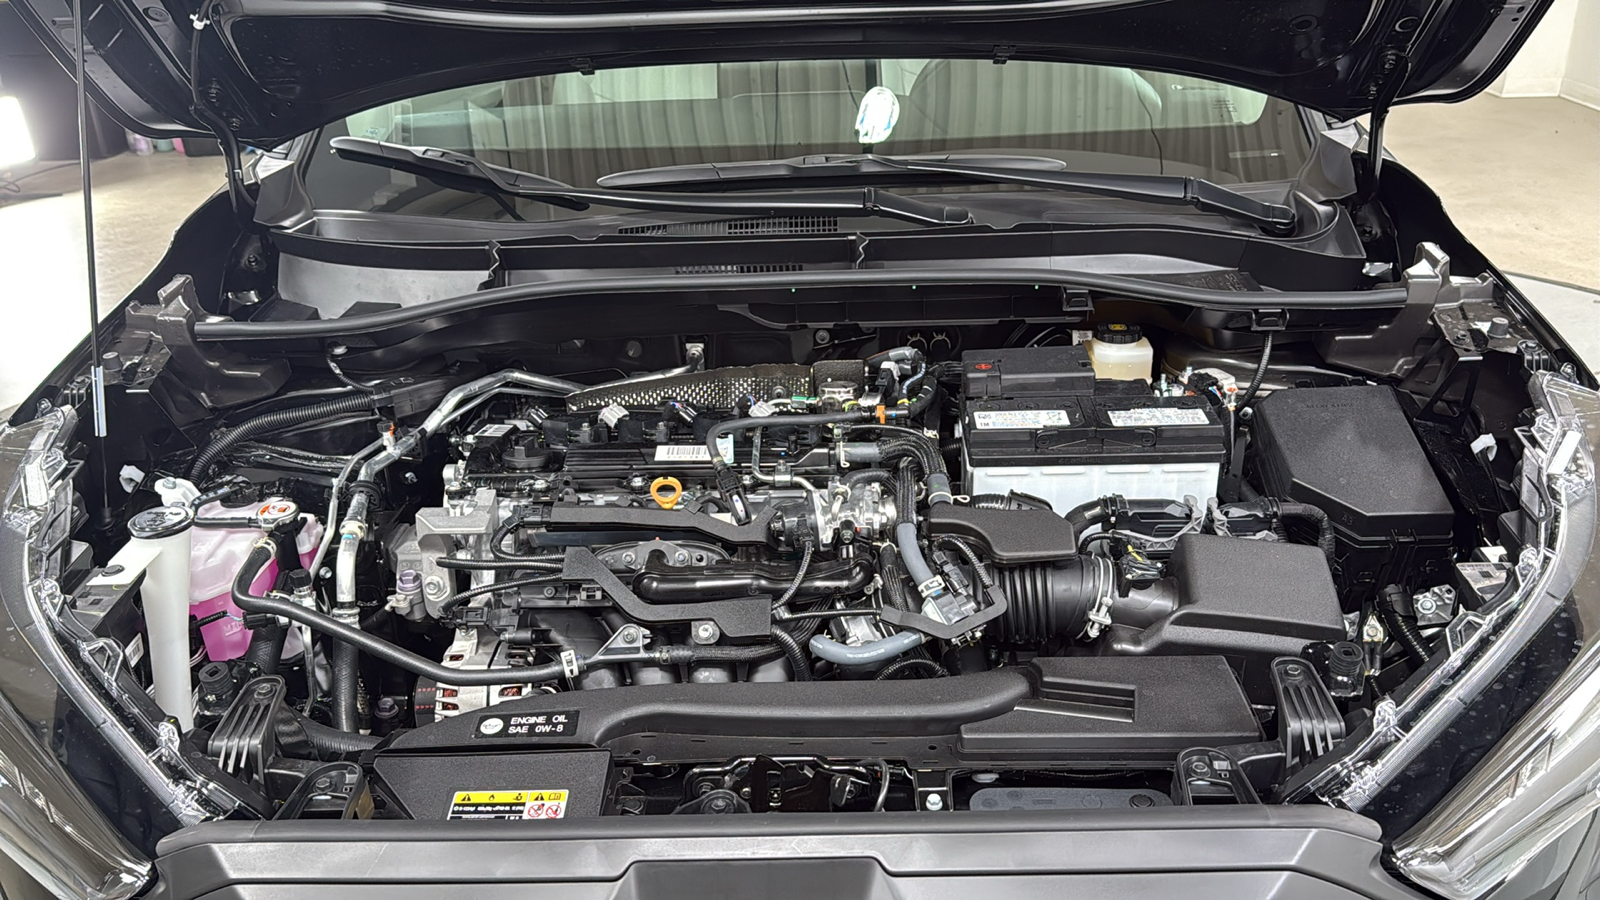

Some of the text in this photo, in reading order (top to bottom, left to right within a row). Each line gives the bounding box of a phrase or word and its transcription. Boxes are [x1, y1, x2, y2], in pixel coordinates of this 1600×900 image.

[510, 715, 568, 724] ENGINE OIL
[508, 724, 563, 733] SAE 0W-8
